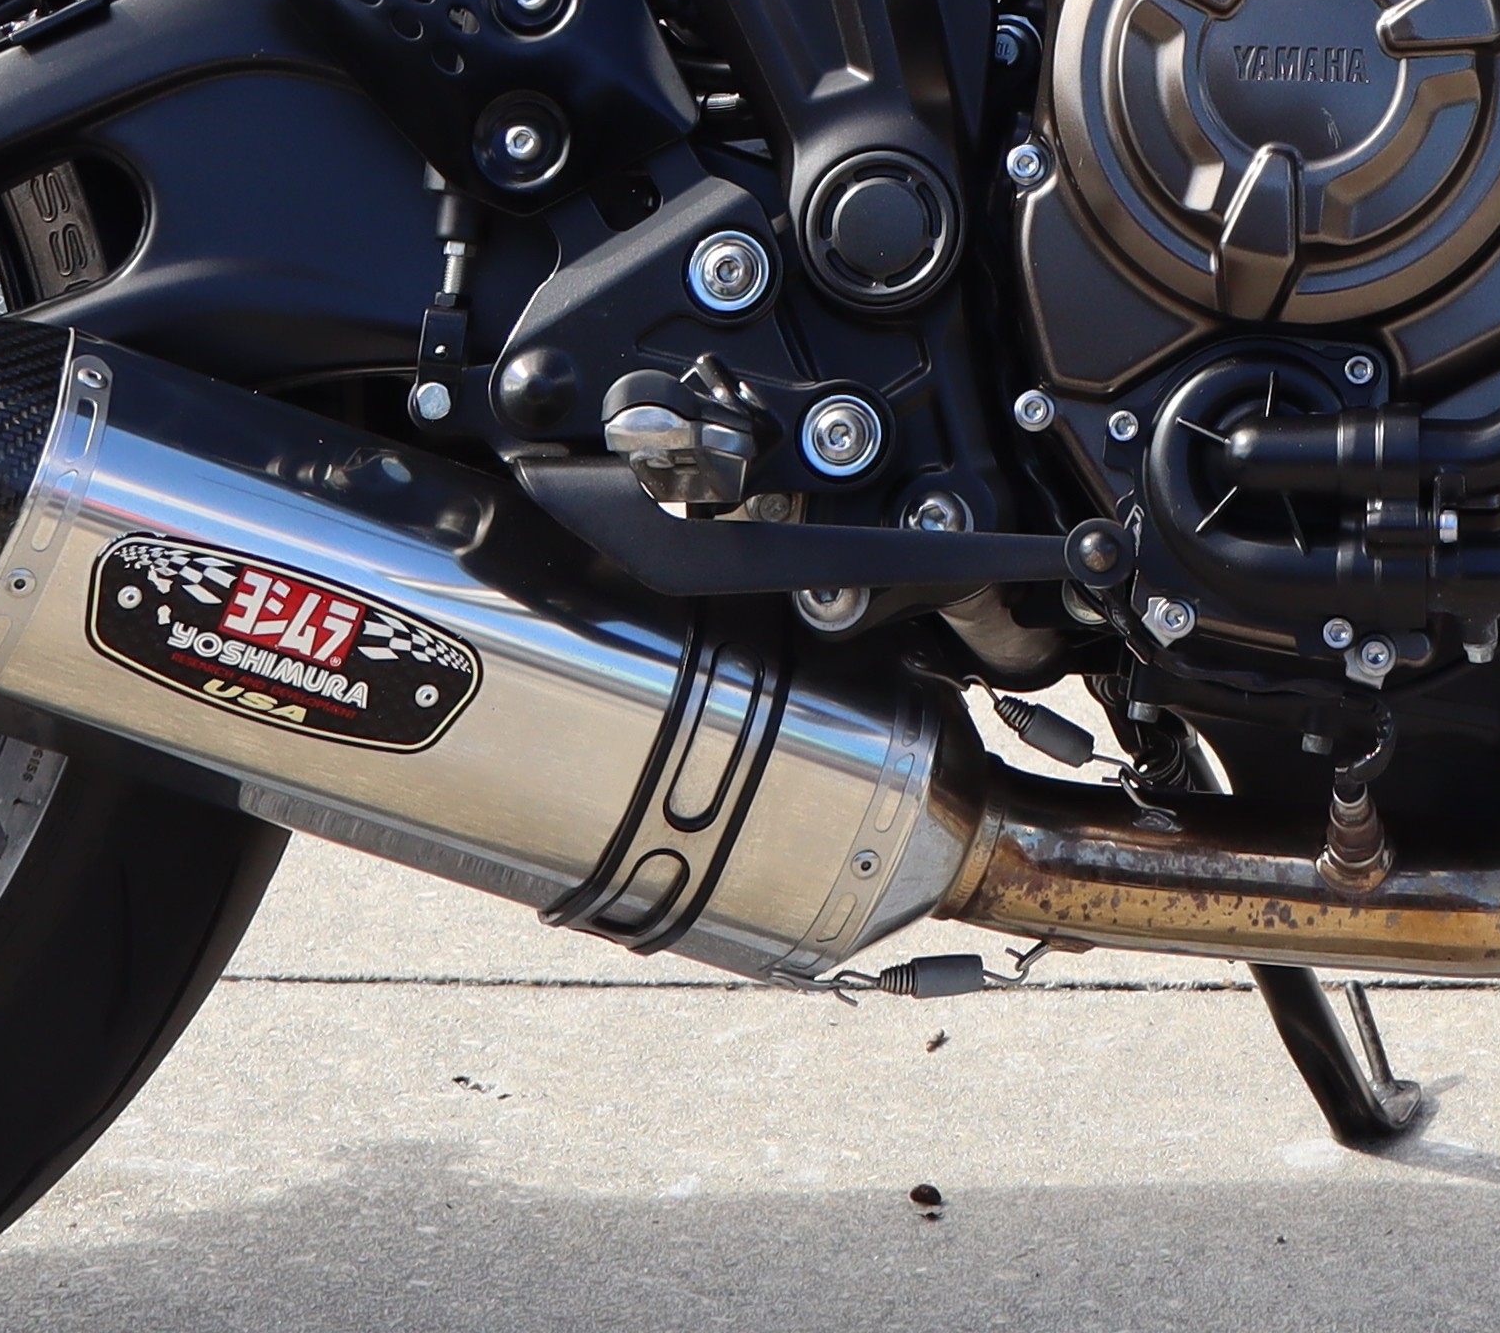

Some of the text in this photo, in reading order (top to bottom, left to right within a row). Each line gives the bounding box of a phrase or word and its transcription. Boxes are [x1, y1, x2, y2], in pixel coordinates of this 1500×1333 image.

[1232, 45, 1369, 84] YAMAHA
[168, 622, 368, 710] YOSHIMURA
[171, 653, 359, 719] RESEARCH AND DEVELOPMENT
[201, 679, 308, 722] USA
